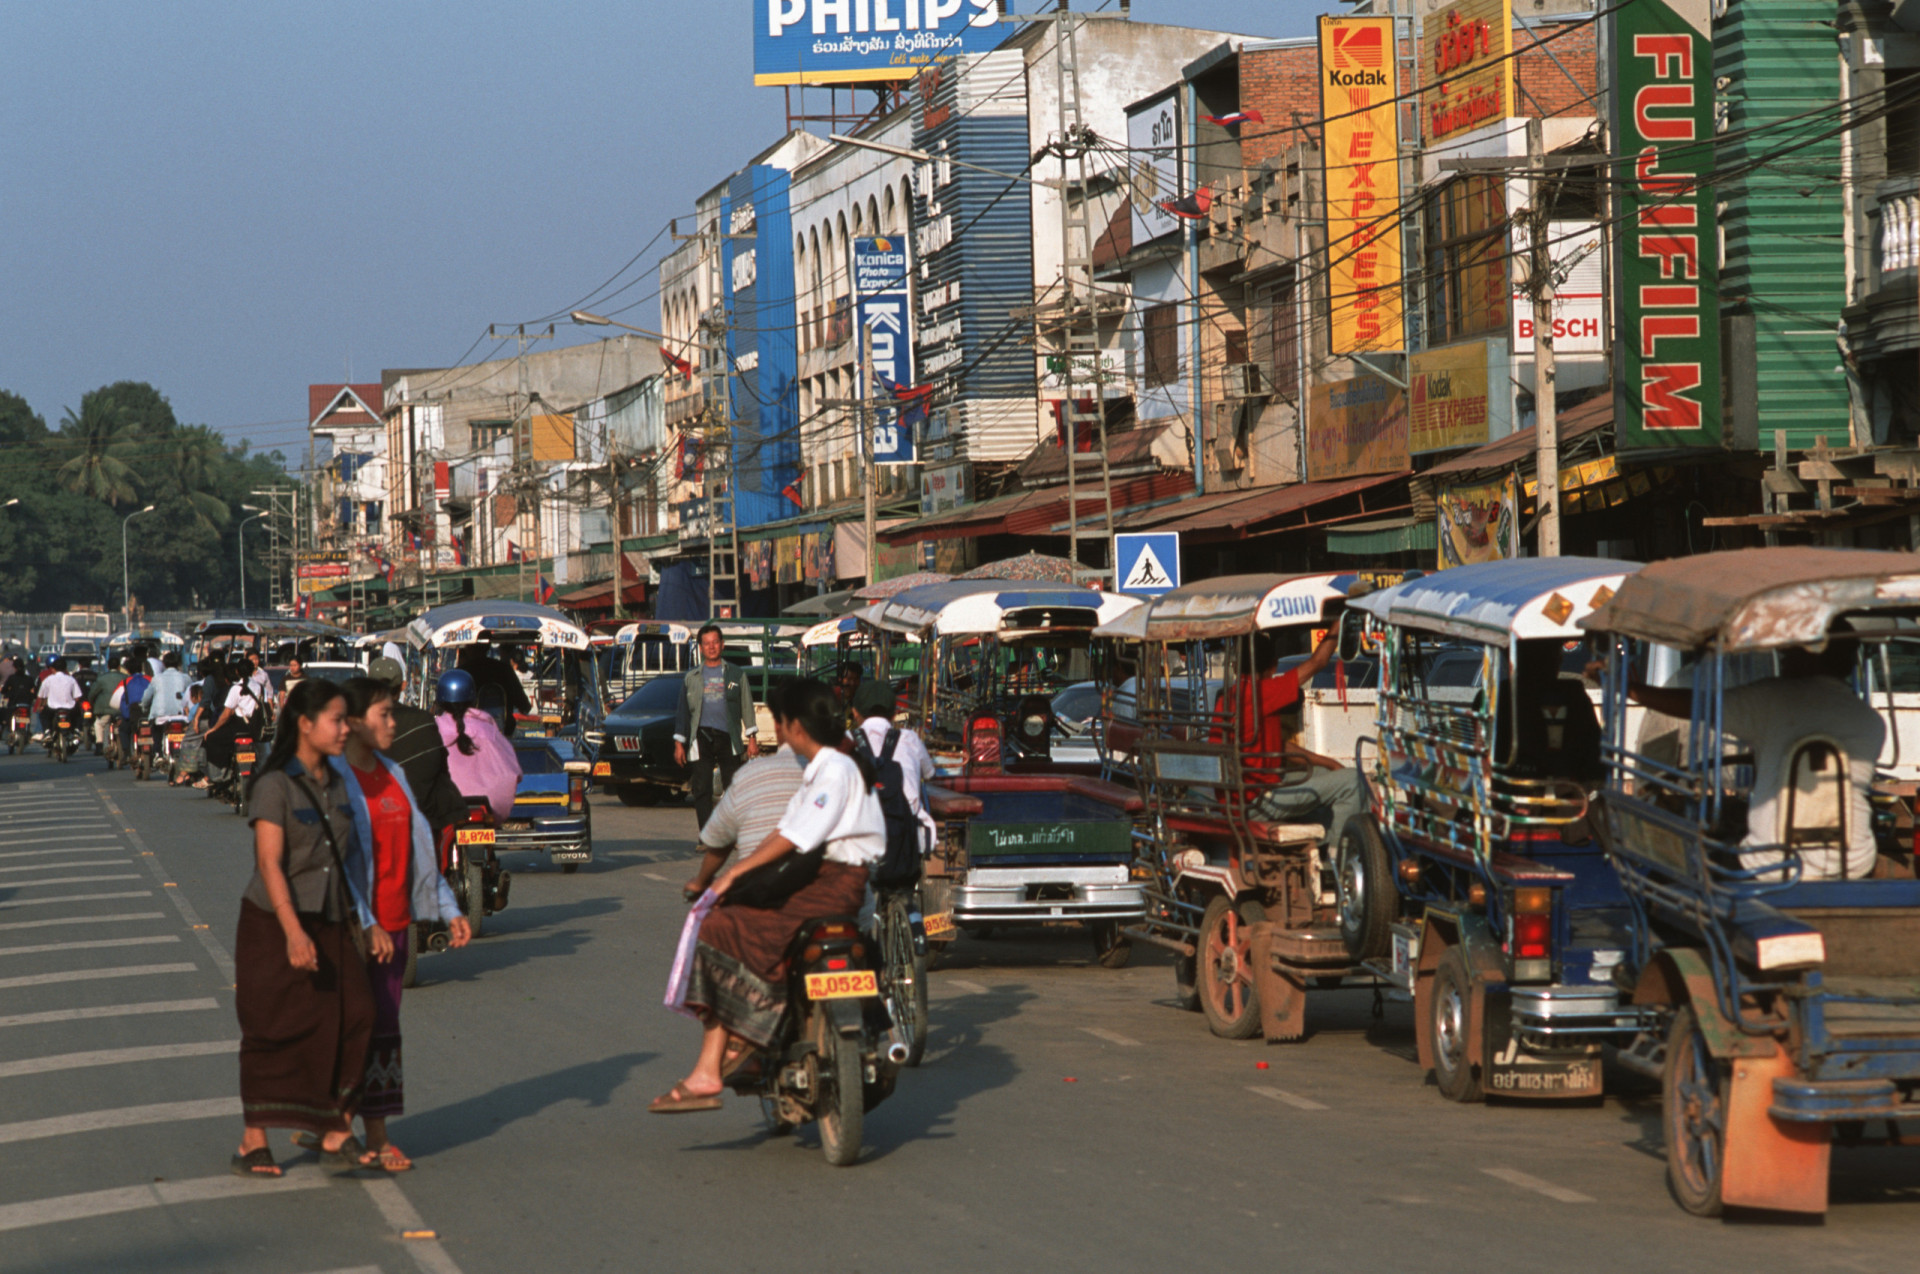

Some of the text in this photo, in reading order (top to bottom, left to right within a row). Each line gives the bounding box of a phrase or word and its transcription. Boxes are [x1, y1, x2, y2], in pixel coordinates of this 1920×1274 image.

[769, 0, 999, 36] PHILIPS
[1329, 69, 1387, 86] Kodak
[1348, 131, 1381, 339] EXPRESS
[1634, 34, 1702, 430] FUJIFILM
[857, 253, 904, 267] Konica
[859, 267, 889, 278] Photo
[1519, 318, 1598, 338] BSCH
[864, 302, 901, 454] Konca
[1428, 370, 1452, 400] Kodak
[1437, 395, 1486, 431] EXPRESS
[1270, 594, 1317, 618] 2000
[470, 831, 494, 843] 8741
[826, 974, 875, 993] 0523
